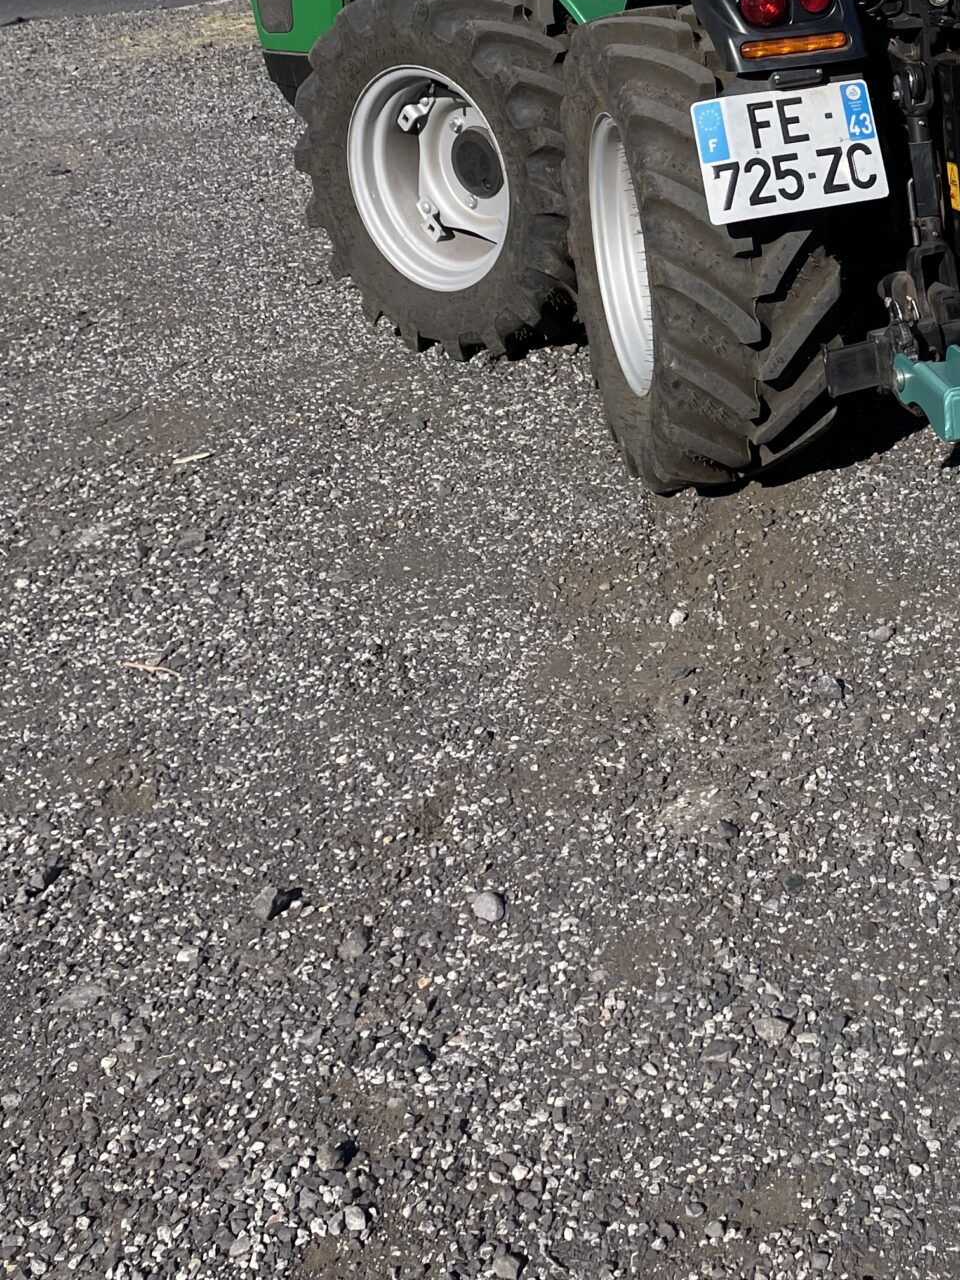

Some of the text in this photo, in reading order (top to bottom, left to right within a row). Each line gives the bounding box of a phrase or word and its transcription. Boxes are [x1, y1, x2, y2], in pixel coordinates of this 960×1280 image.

[849, 113, 873, 136] 43
[708, 138, 718, 153] F
[711, 142, 877, 211] 725-ZC
